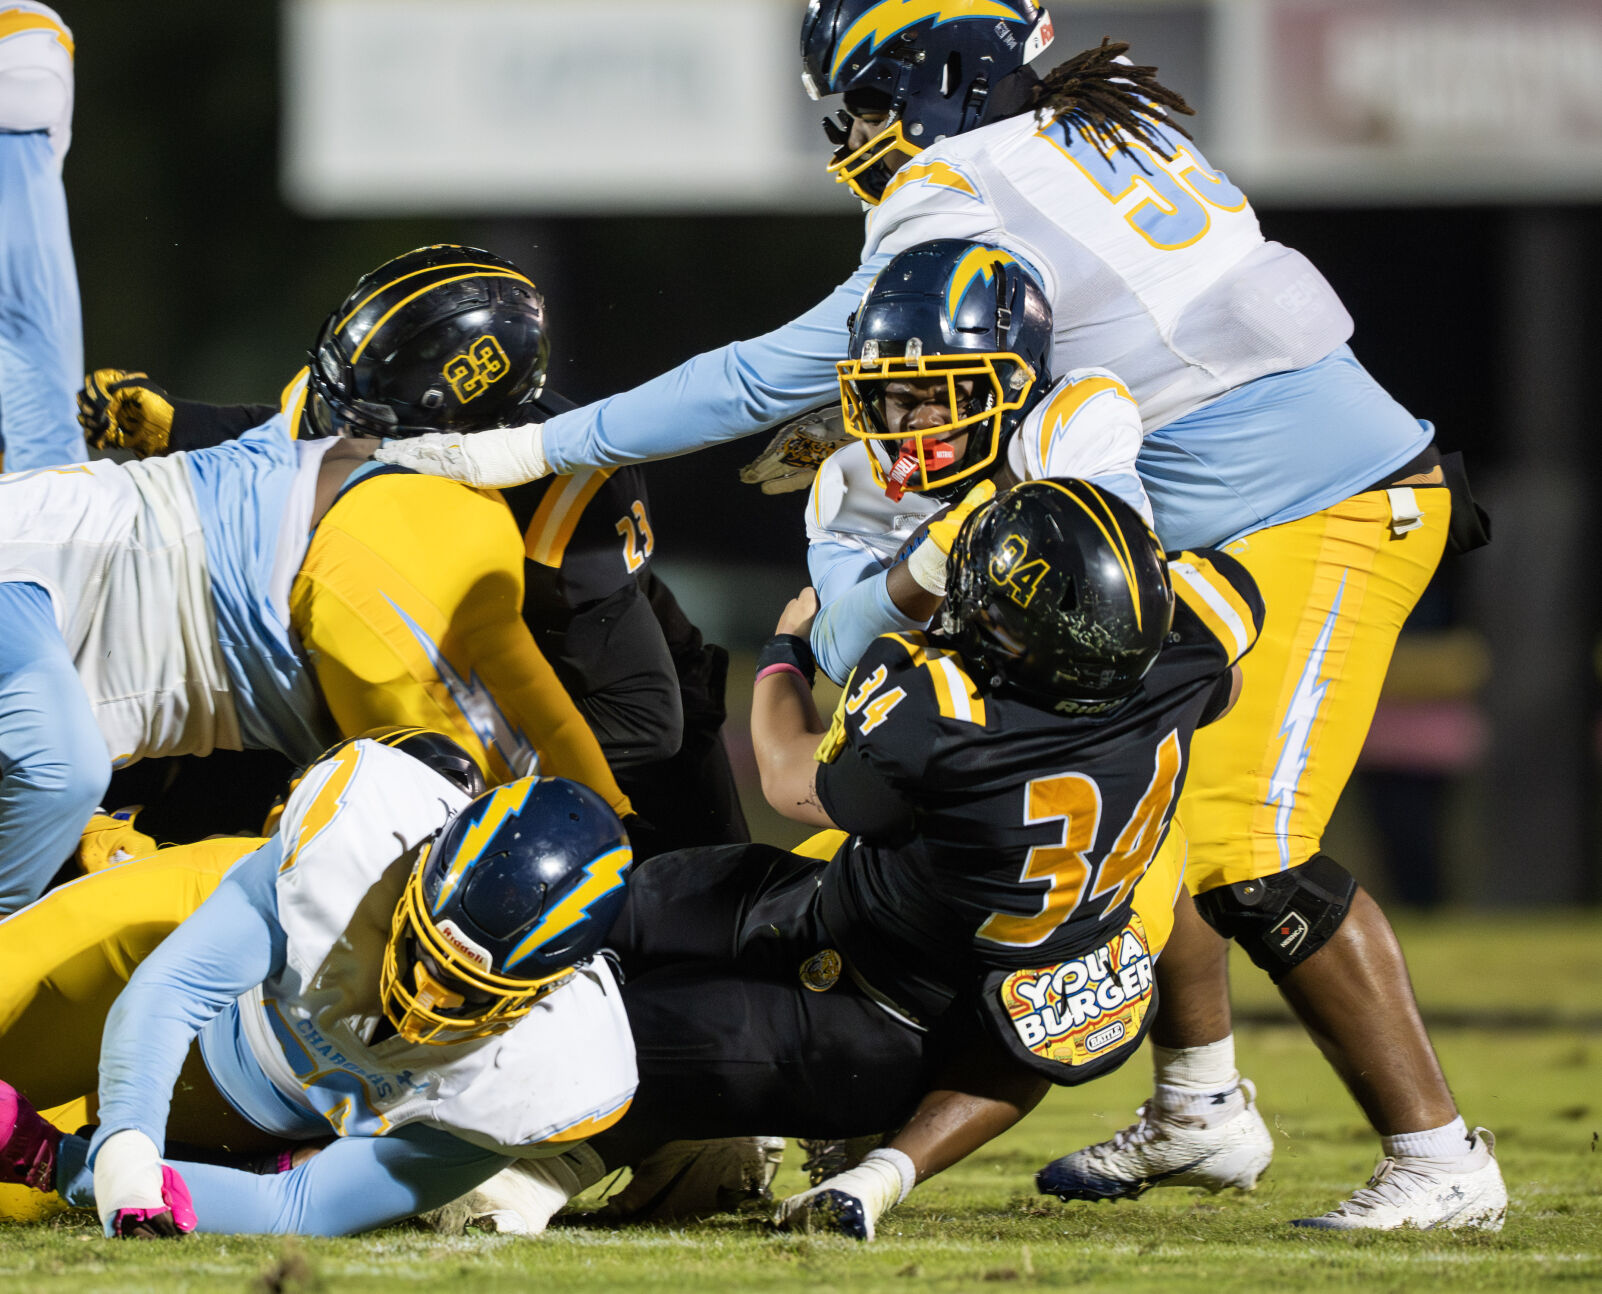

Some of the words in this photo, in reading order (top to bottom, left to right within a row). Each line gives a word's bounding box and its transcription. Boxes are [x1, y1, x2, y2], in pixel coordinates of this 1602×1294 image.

[443, 335, 511, 404] 23
[615, 500, 655, 574] 23
[989, 534, 1051, 609] 34
[845, 664, 907, 736] 34
[975, 728, 1182, 948] 34
[442, 926, 485, 965] Riddell
[1016, 947, 1109, 1010] YOU
[1120, 931, 1143, 966] A
[1014, 955, 1152, 1048] BURGER
